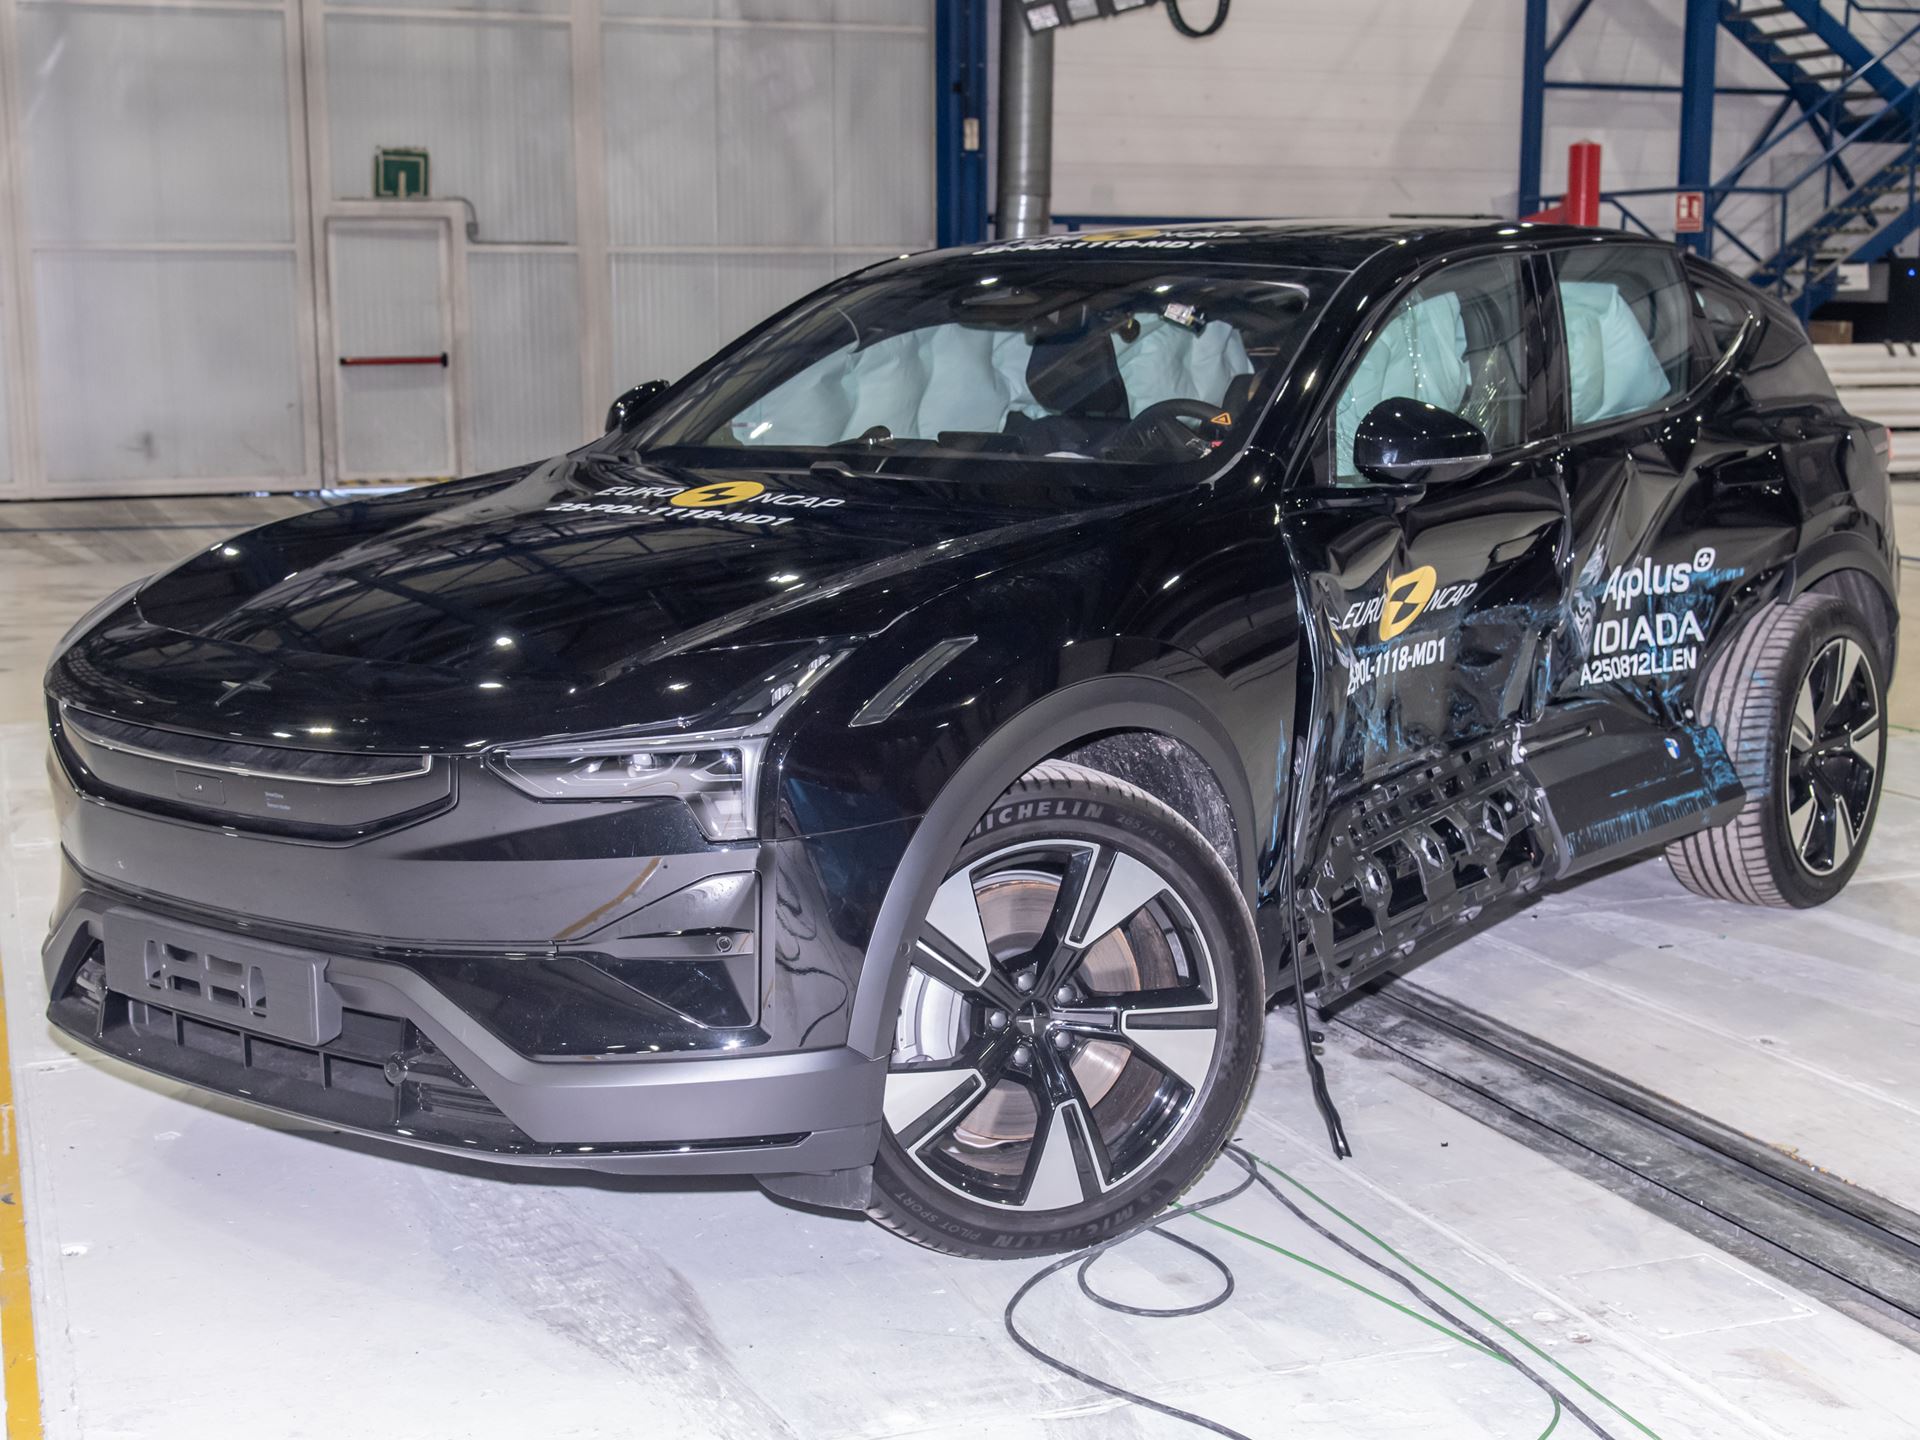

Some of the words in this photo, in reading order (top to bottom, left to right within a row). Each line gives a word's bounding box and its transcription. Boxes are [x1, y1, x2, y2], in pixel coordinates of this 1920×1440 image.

[594, 486, 685, 498] EURO
[748, 491, 846, 509] NCAP
[1341, 593, 1388, 631] EURO
[1422, 582, 1478, 613] NCAP
[1593, 609, 1706, 657] IDIADA
[1579, 646, 1697, 687] A250812LLEN
[894, 1191, 939, 1223] SPORT
[941, 1220, 982, 1241] PILOT
